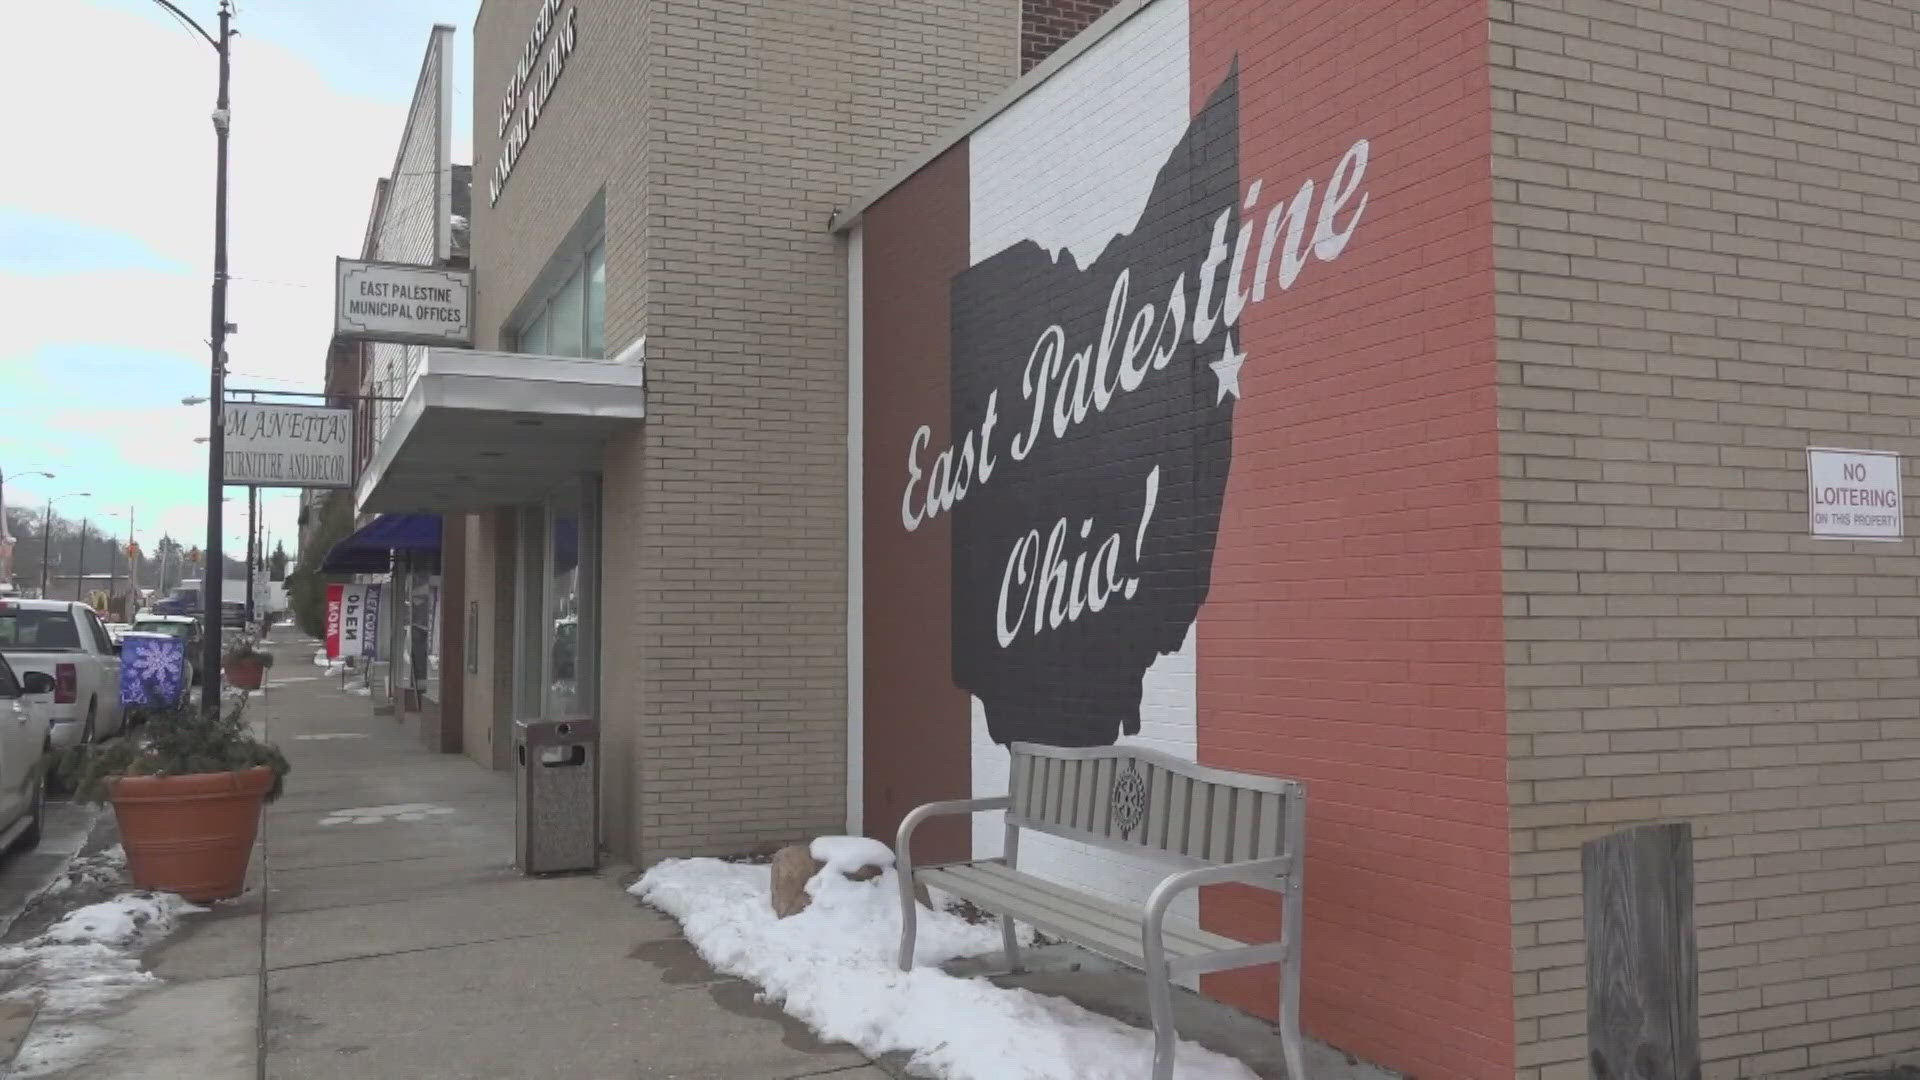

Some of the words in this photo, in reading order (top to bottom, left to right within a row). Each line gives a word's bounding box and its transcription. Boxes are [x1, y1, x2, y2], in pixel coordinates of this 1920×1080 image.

[499, 74, 517, 138] EAST
[515, 0, 562, 98] PALESTIN
[528, 7, 576, 130] BUILDING
[360, 280, 389, 297] EAST
[391, 283, 452, 303] PALESTINE
[349, 299, 413, 319] MUNICIPAL
[415, 305, 461, 322] OFFICES
[902, 389, 998, 531] East
[1011, 139, 1370, 462] Palestine
[224, 450, 283, 479] FURNITURE
[311, 454, 345, 481] DECOR
[1843, 463, 1867, 482] NO
[1815, 487, 1897, 508] LOITERING
[1815, 513, 1828, 525] ON
[1831, 513, 1851, 526] THIS
[1853, 514, 1898, 528] PROPERTY
[996, 464, 1160, 648] Ohio!
